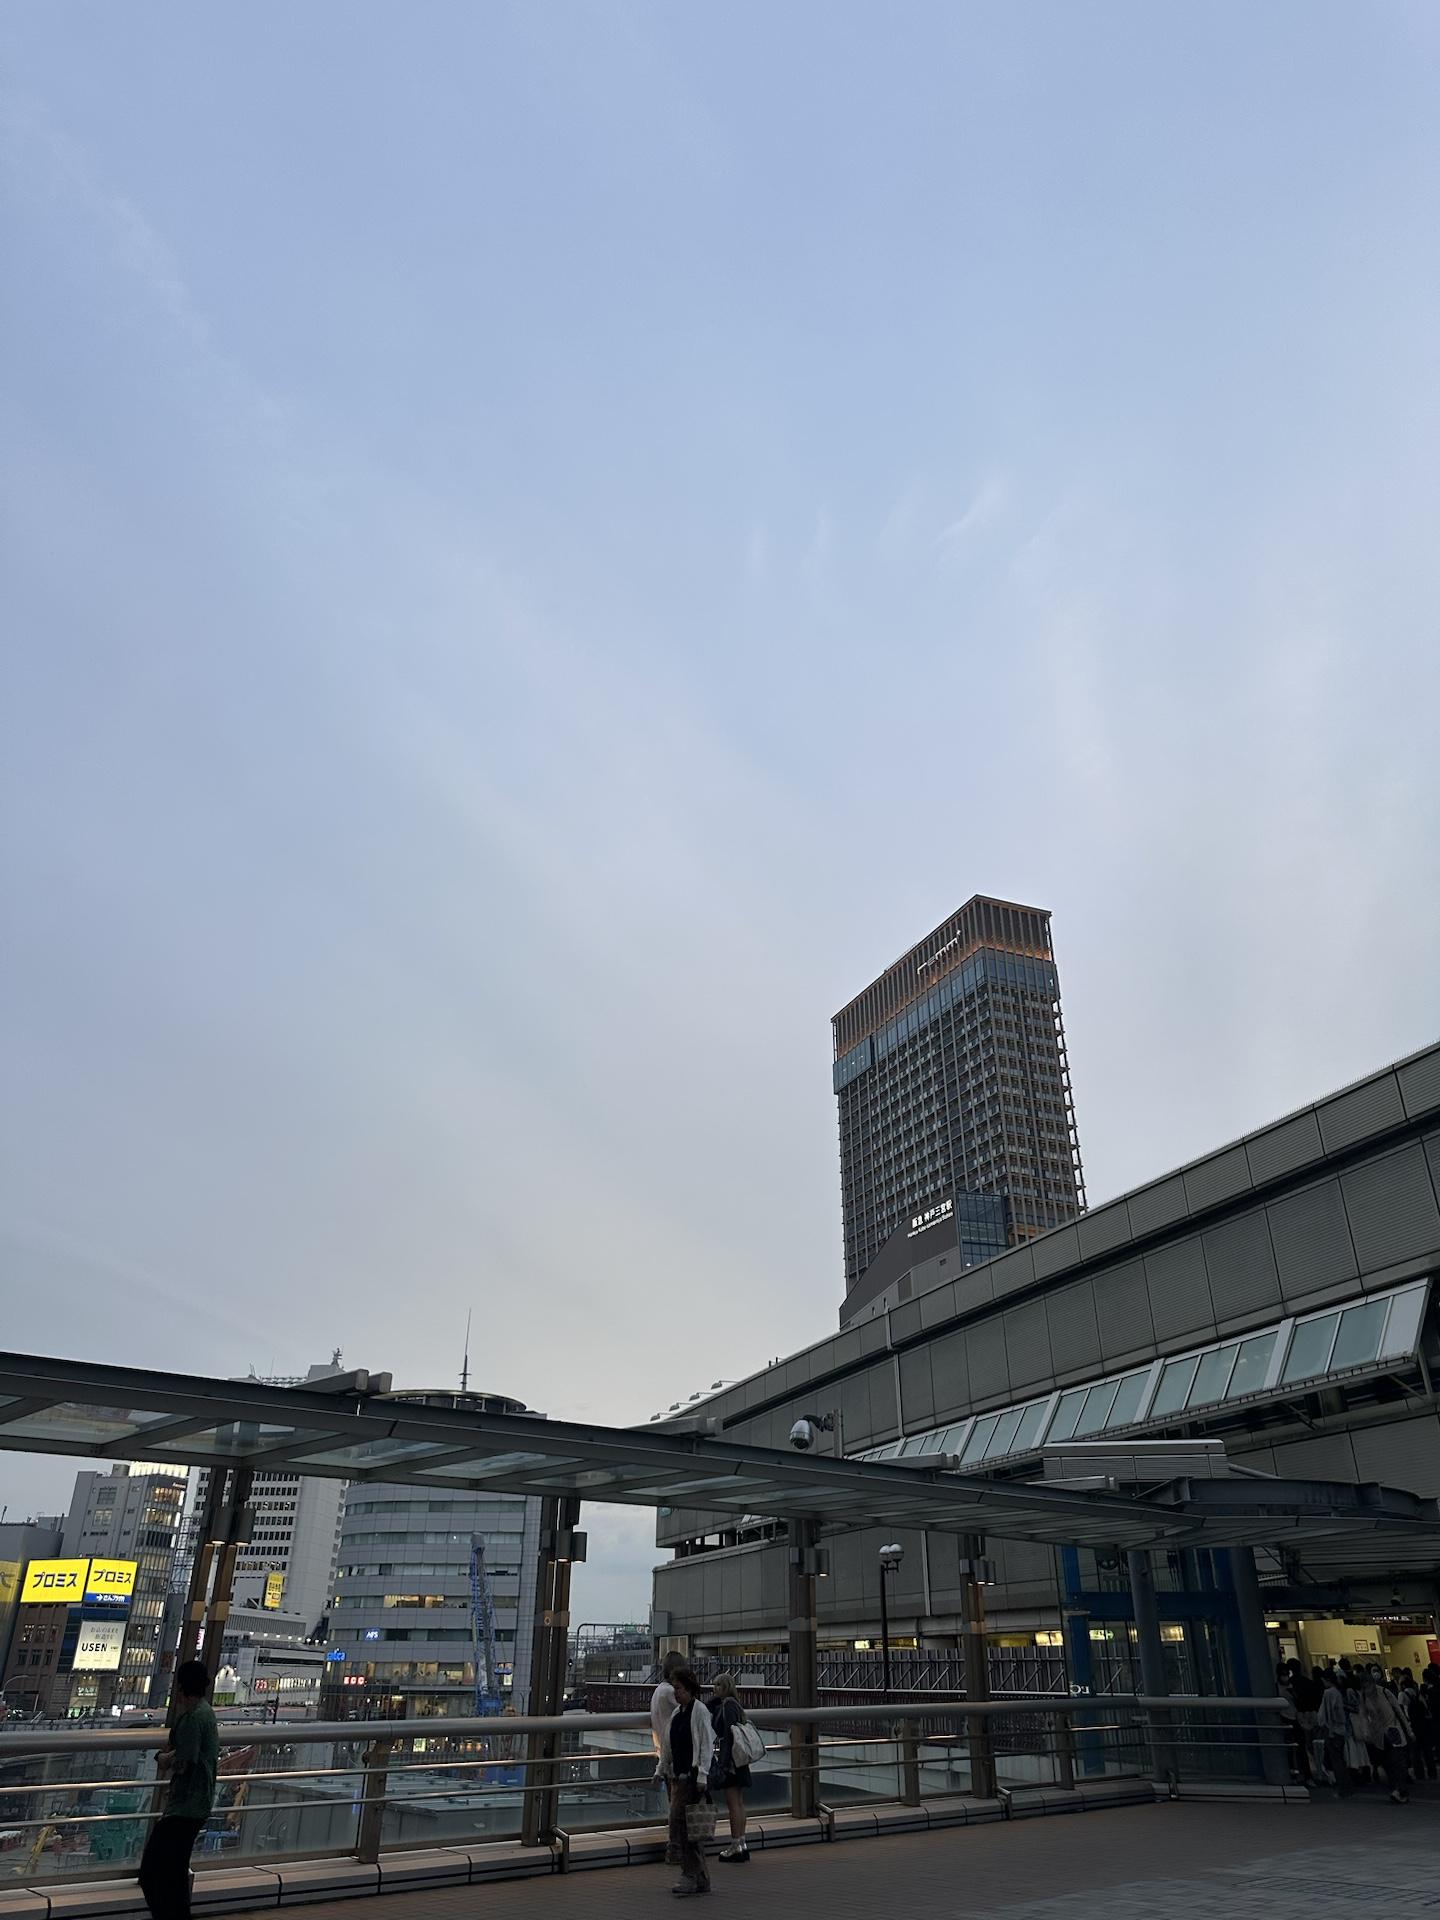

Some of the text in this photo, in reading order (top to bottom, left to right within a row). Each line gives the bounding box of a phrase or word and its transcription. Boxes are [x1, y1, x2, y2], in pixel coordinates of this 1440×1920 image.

[32, 1571, 78, 1588] プロミス
[93, 1569, 132, 1584] プロミス
[81, 1643, 107, 1652] USEN
